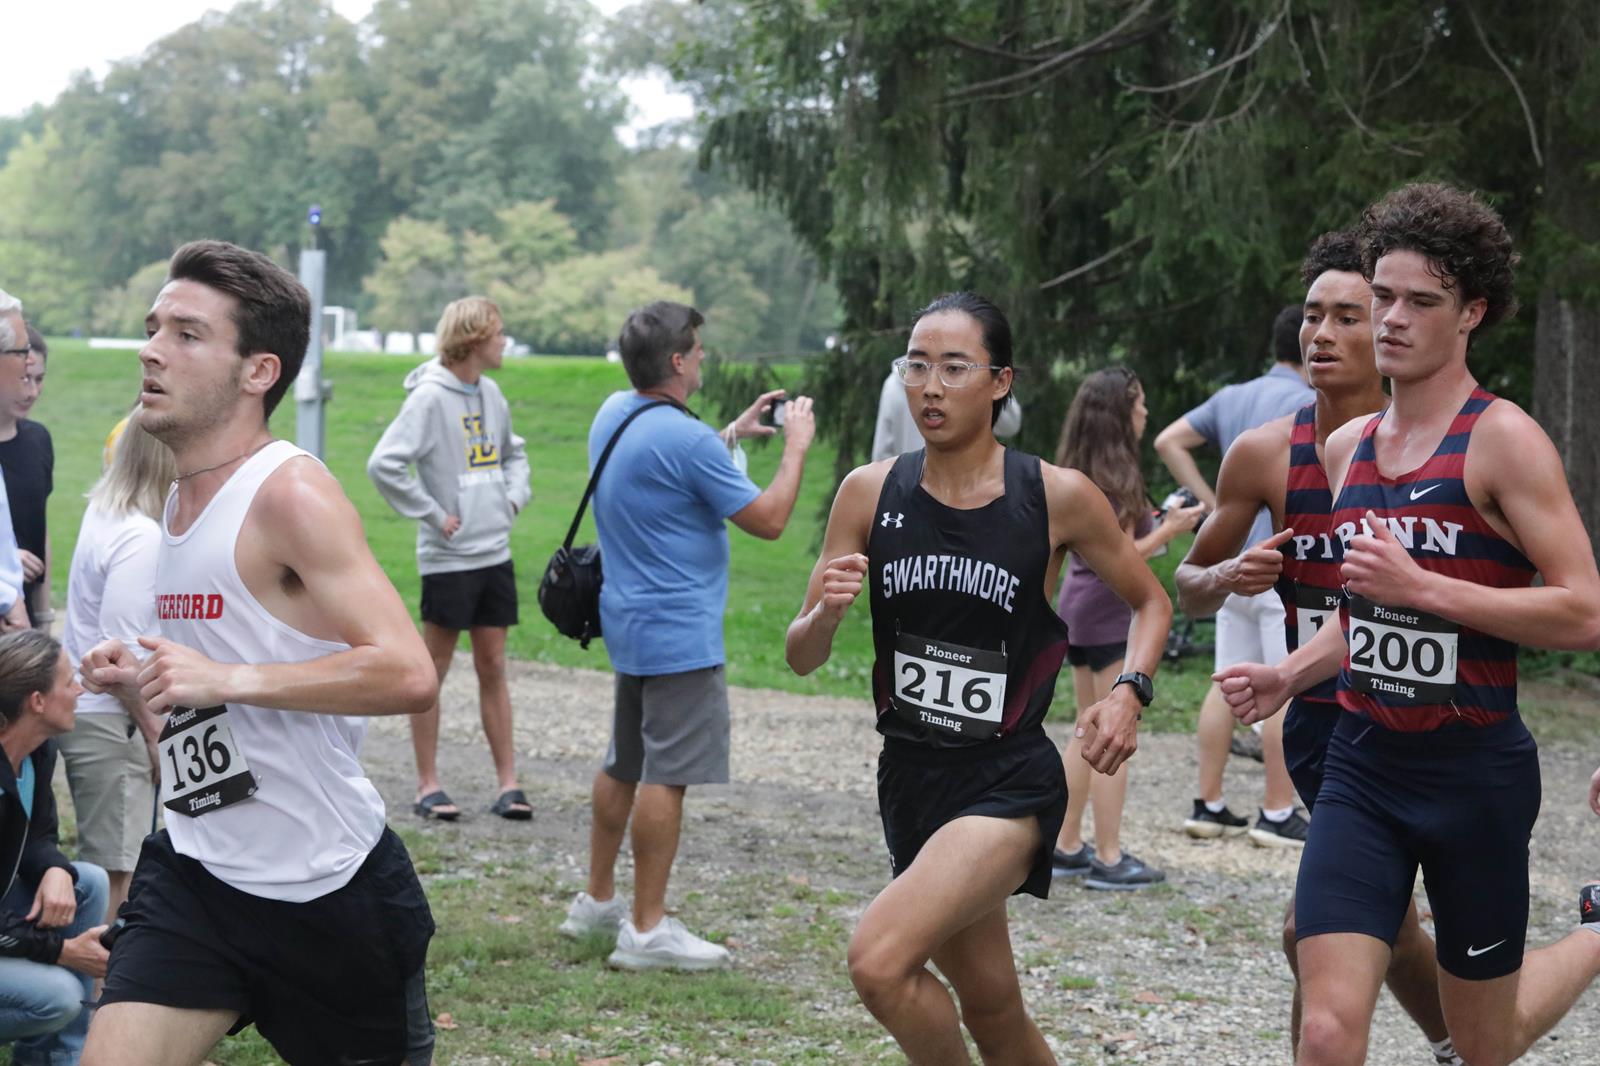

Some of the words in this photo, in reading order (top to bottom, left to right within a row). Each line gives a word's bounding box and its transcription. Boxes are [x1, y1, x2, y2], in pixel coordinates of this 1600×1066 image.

[882, 555, 1021, 613] SWARTHMORE
[1373, 606, 1419, 624] Pioneer
[925, 644, 972, 664] Pioneer
[1351, 626, 1445, 678] 200
[901, 662, 993, 714] 216
[1370, 678, 1415, 698] Timing
[170, 708, 197, 728] Pioneer
[919, 710, 963, 732] Timing
[167, 724, 231, 792] 136
[189, 791, 222, 811] Timing
